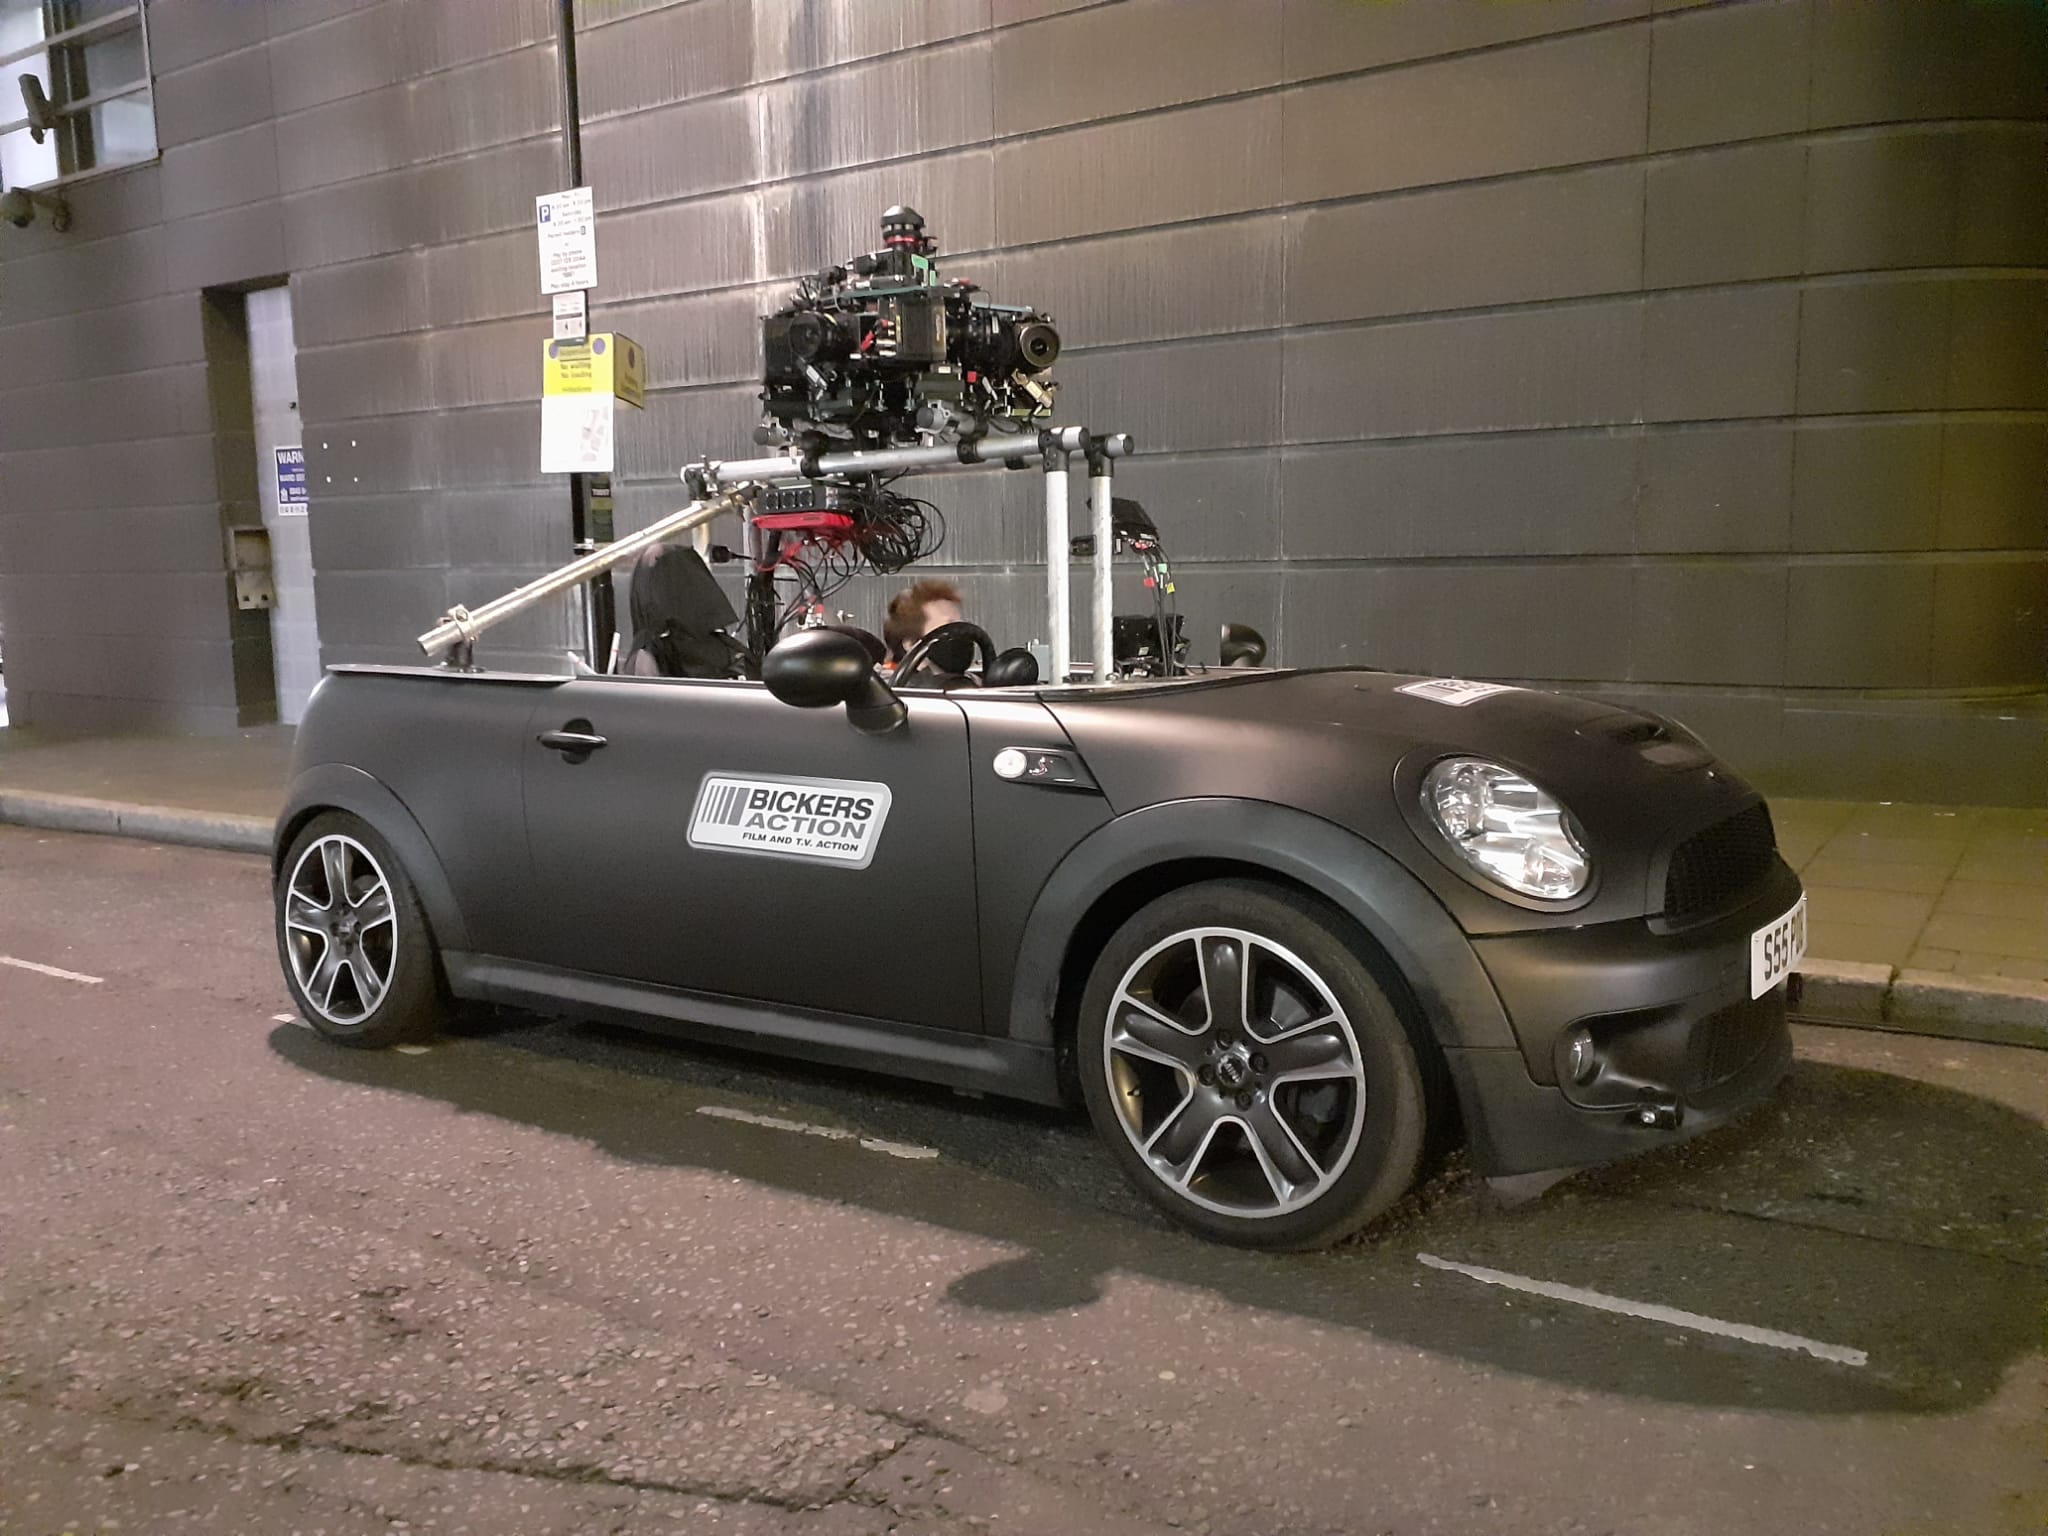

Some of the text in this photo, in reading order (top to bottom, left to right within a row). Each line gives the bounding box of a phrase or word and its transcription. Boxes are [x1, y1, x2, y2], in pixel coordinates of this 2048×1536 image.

[748, 788, 875, 821] BICKERS
[744, 812, 867, 840] ACTION
[741, 831, 859, 852] FILM AND T.V. ACTION
